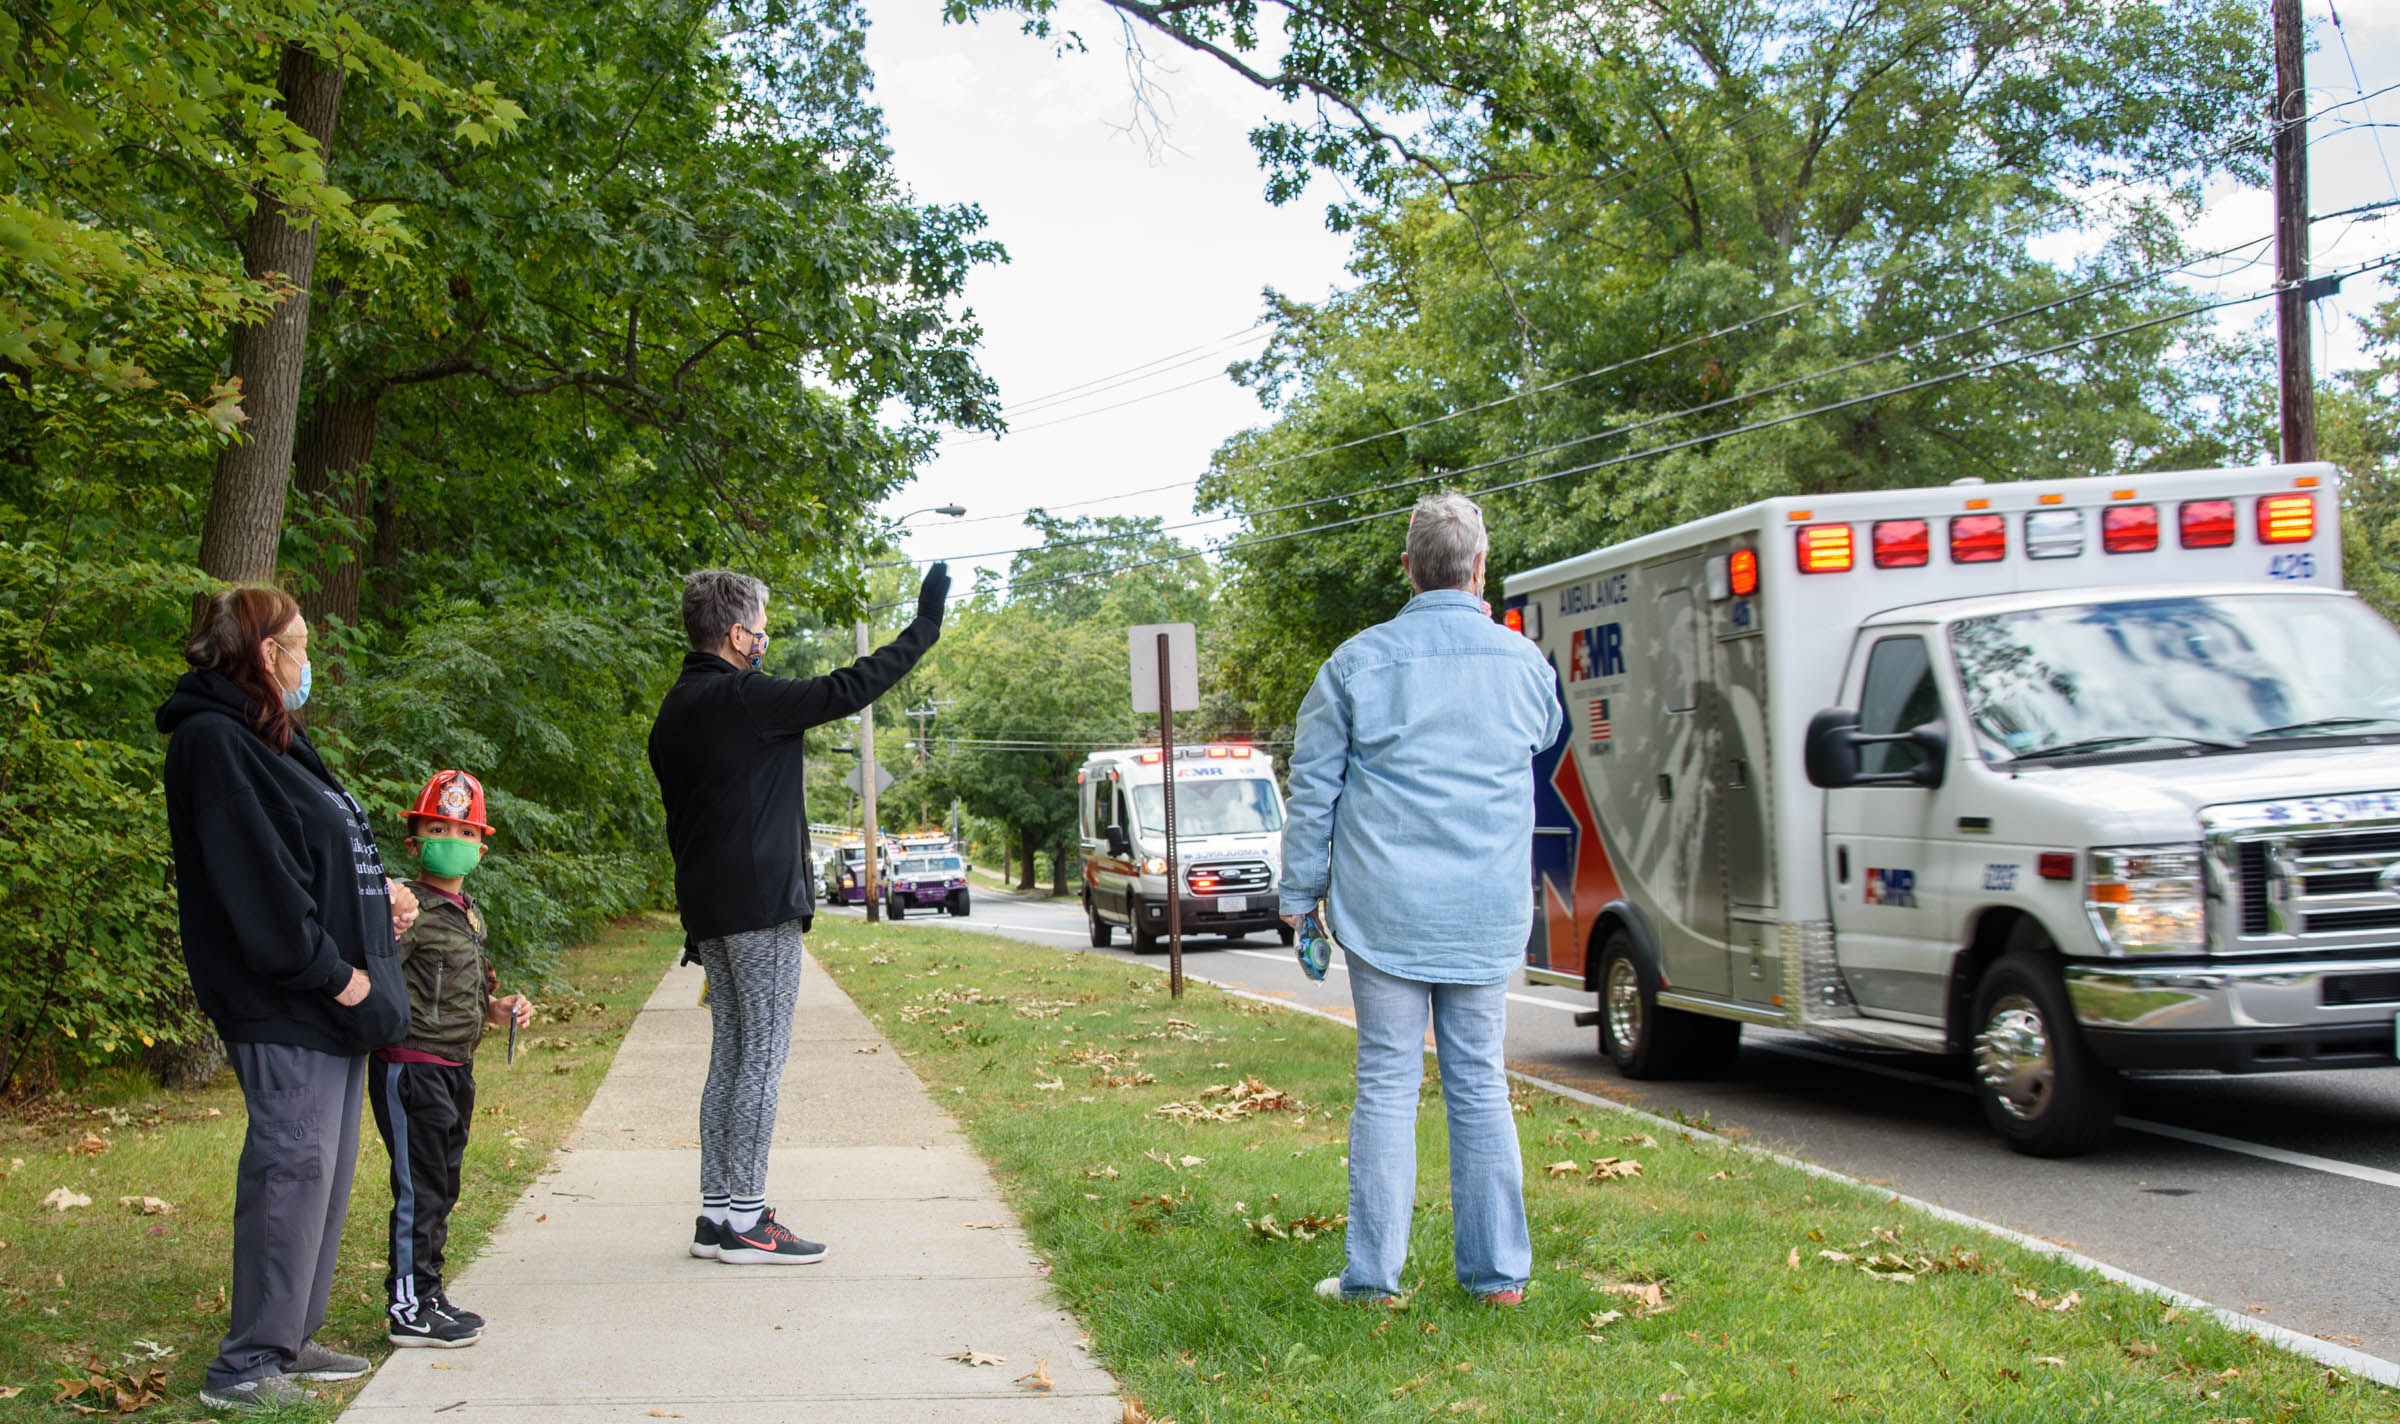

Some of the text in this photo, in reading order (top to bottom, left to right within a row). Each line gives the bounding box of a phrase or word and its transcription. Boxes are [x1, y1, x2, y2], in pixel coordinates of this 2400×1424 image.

[1560, 573, 1628, 616] AMBULANCE
[1569, 621, 1626, 683] AMR
[1177, 767, 1224, 777] AMR
[1864, 867, 1919, 909] AMR
